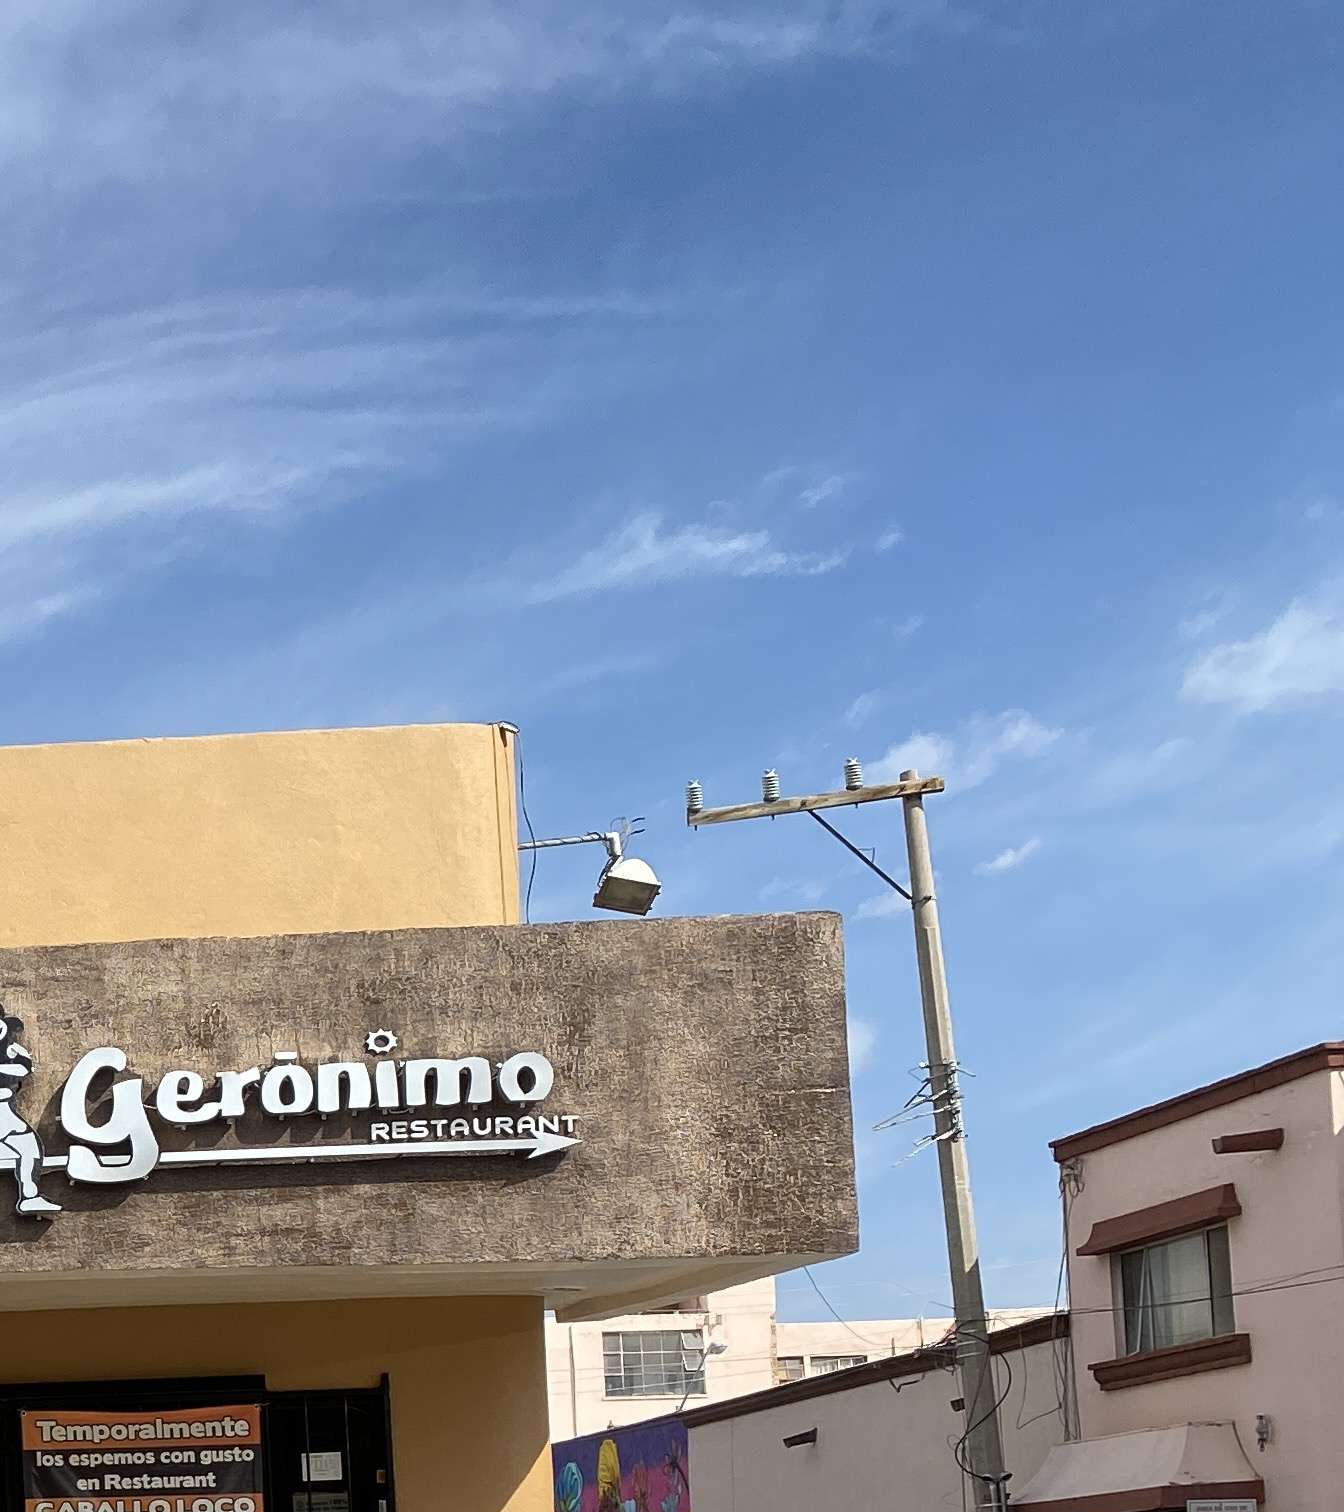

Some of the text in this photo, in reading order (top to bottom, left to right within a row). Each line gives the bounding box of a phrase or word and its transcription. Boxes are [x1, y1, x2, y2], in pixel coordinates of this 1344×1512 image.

[370, 1115, 580, 1142] RESTAURANT
[35, 1416, 250, 1443] Temporalmente
[36, 1447, 254, 1468] los espemos con gusto
[76, 1472, 216, 1491] en Restaurant
